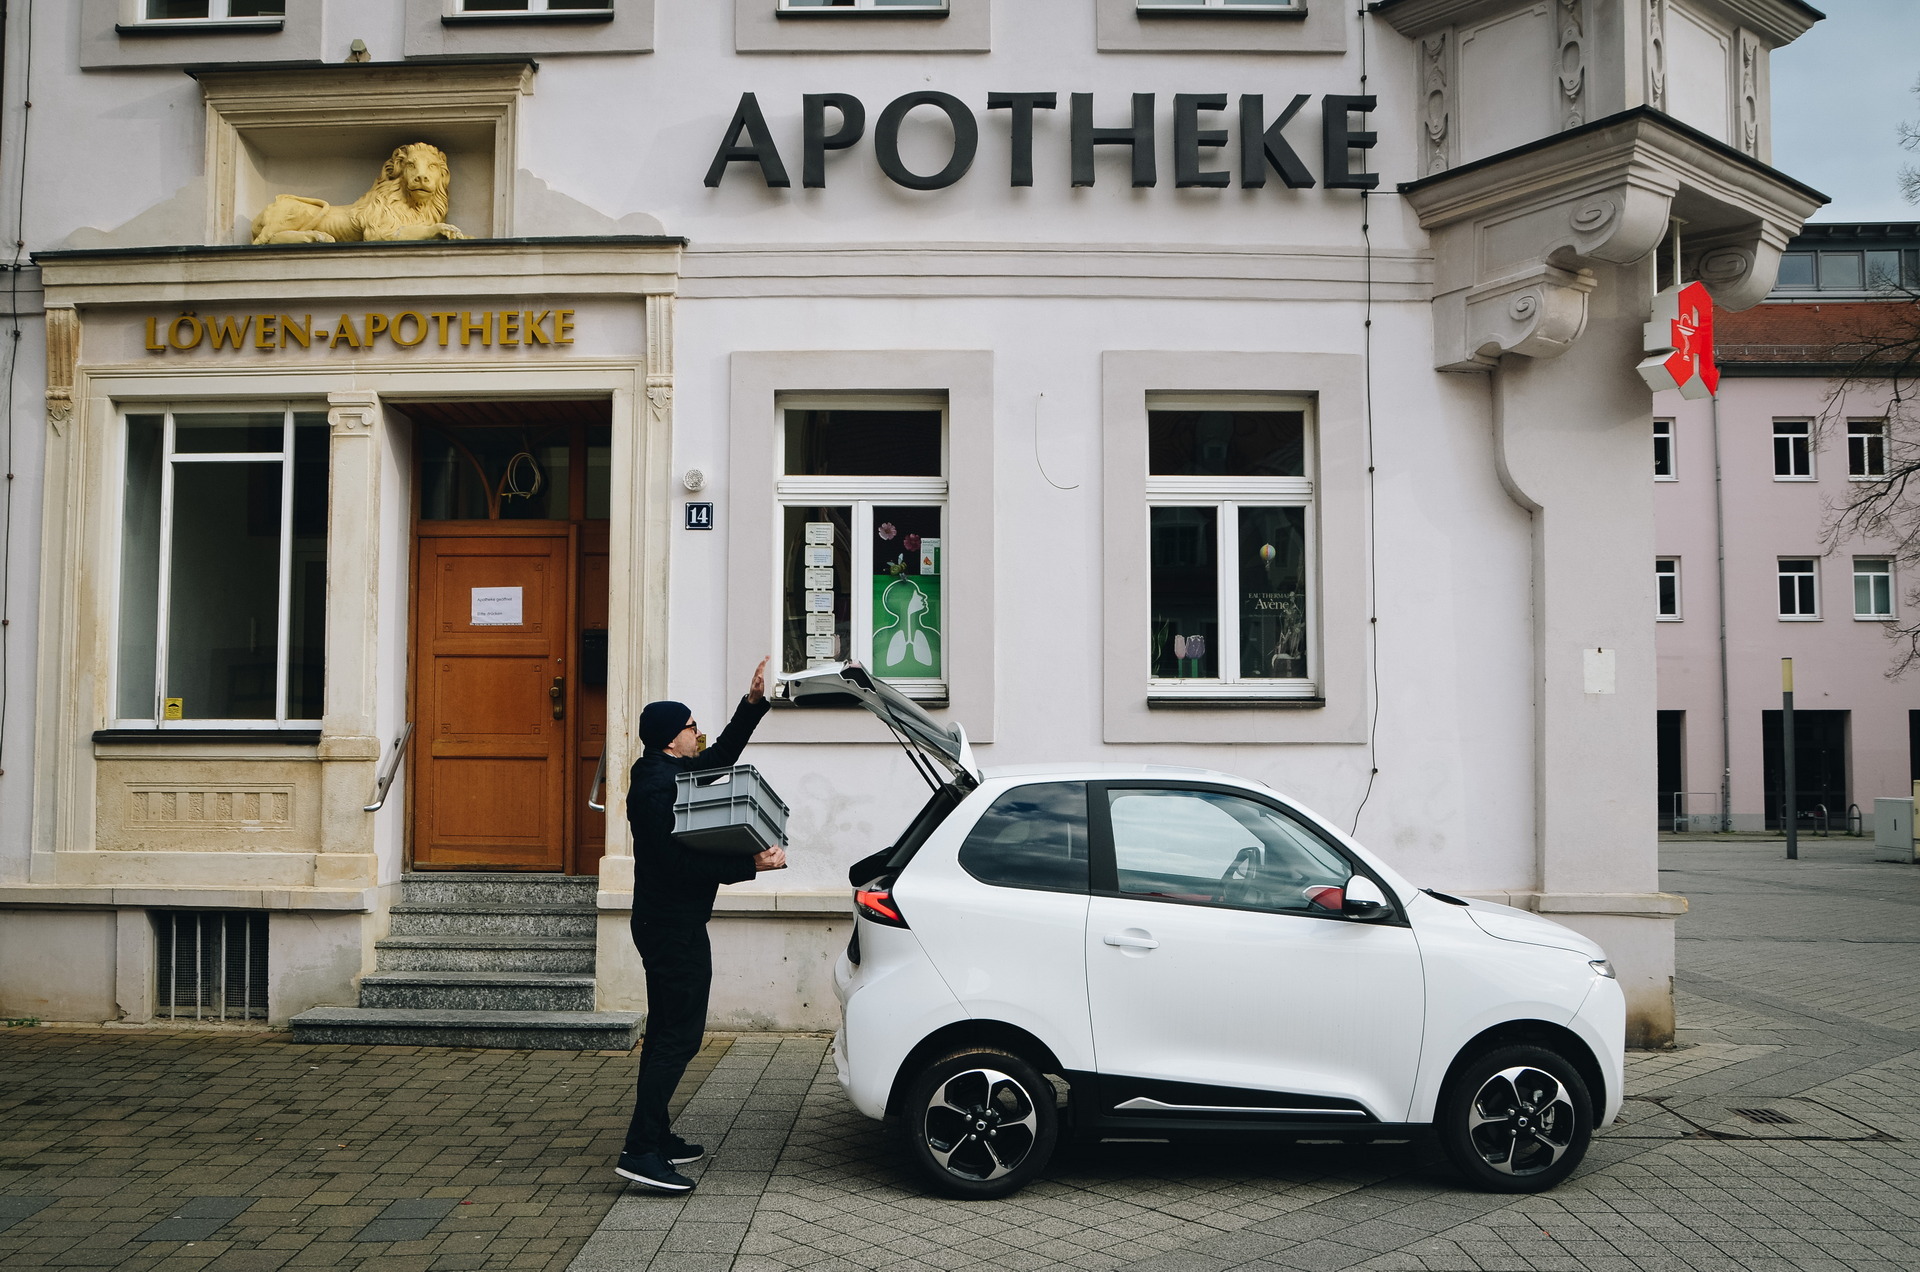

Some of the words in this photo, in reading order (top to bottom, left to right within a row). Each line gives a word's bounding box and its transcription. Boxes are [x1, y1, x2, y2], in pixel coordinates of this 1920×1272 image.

[703, 90, 1379, 190] APOTHEKE
[144, 309, 575, 351] LÖWEN-APOTHEKE
[690, 507, 708, 524] 14
[1255, 598, 1289, 610] Avène
